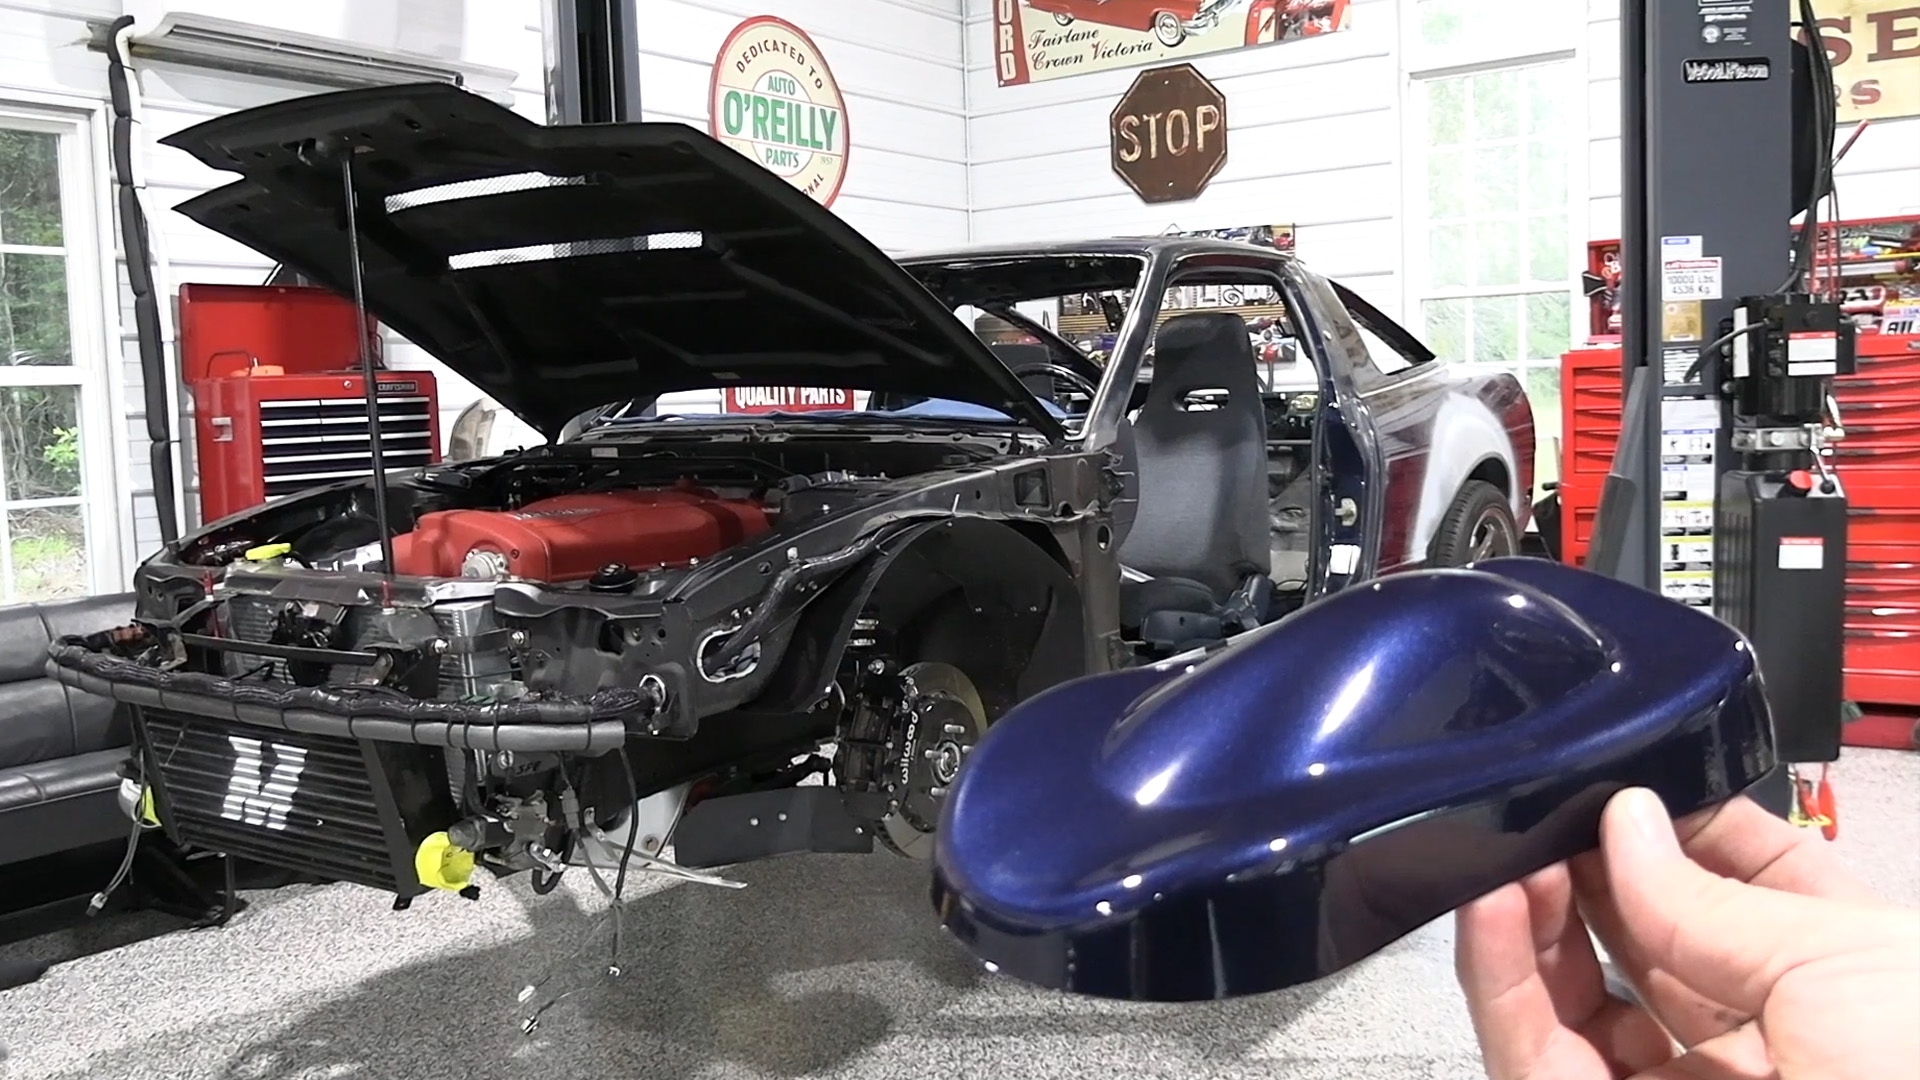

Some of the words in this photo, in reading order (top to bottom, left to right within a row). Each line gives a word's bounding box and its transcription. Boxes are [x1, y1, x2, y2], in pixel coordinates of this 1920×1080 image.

[1028, 28, 1099, 50] Fairlane
[736, 39, 805, 74] DEDICATED
[808, 65, 823, 89] TO
[1031, 51, 1083, 71] Crown
[1090, 40, 1153, 61] Victoria
[767, 75, 796, 96] AUTO
[723, 90, 837, 151] O'REILLY
[1119, 104, 1220, 163] STOP
[765, 147, 799, 169] PARTS
[734, 387, 796, 409] QUALITY
[801, 387, 846, 405] PARTS
